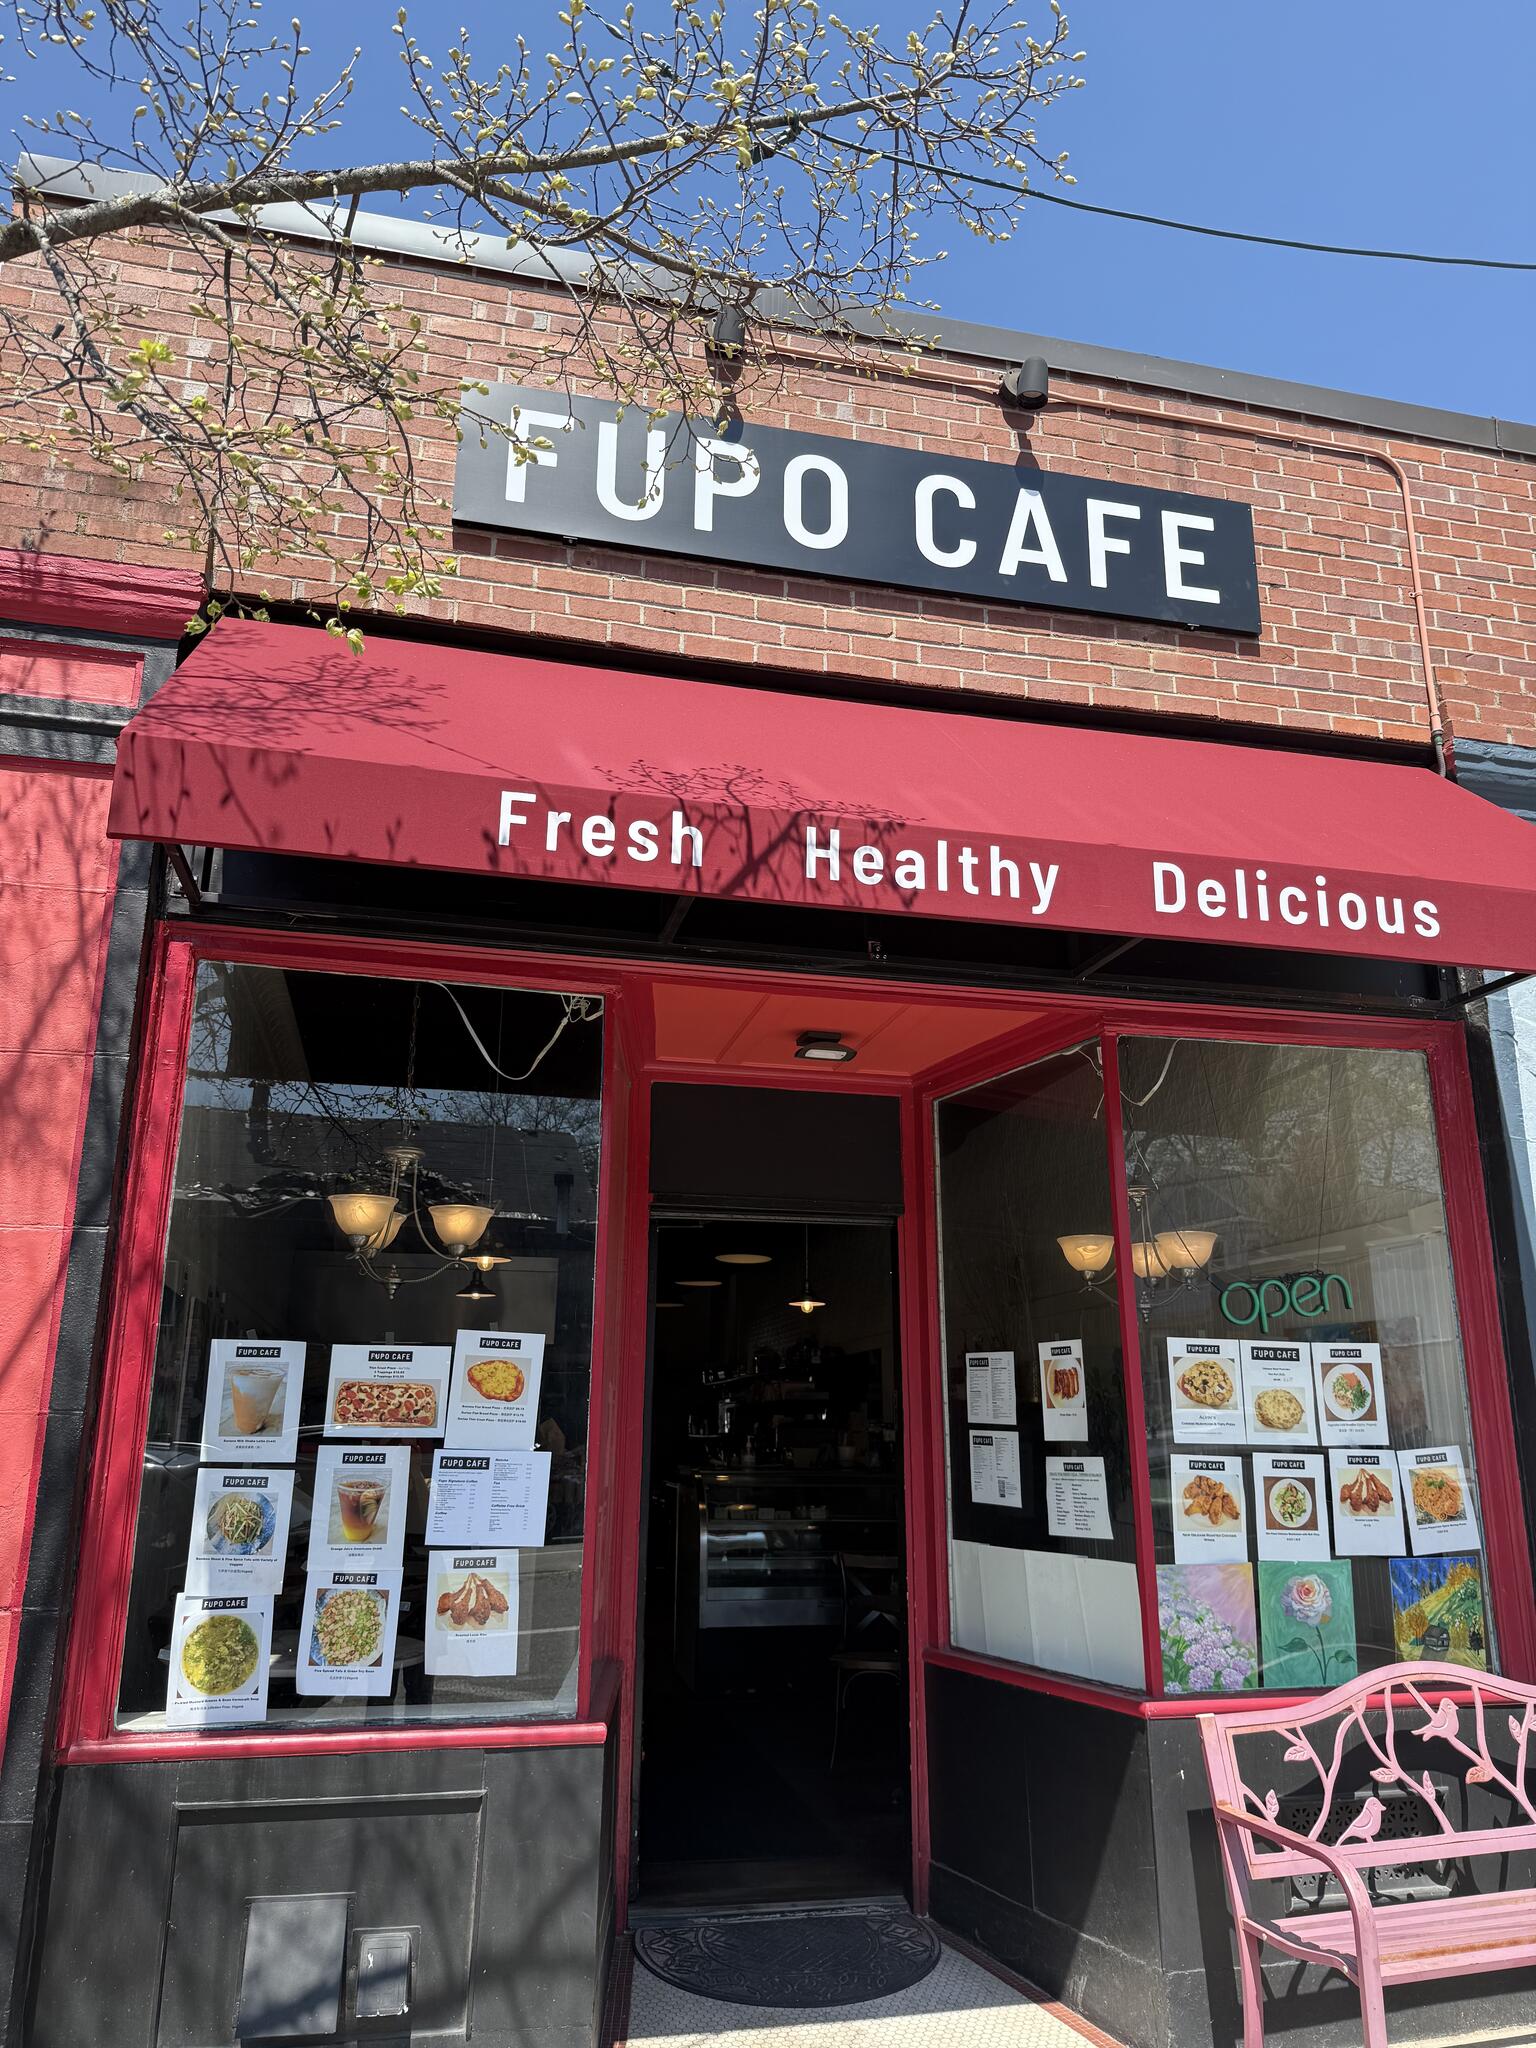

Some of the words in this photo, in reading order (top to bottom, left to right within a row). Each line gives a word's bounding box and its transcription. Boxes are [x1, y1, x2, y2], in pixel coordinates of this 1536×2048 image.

[504, 407, 849, 550] FUPO
[914, 473, 1221, 604] CAFE
[499, 790, 703, 867] Fresh
[804, 825, 1060, 915] Healthy
[1152, 861, 1441, 938] Delicious
[1220, 1273, 1353, 1334] open
[482, 1340, 500, 1348] FUPO
[370, 1352, 390, 1360] FUPO
[392, 1352, 411, 1361] CAFE
[1254, 1350, 1274, 1358] FUPO
[1276, 1350, 1298, 1359] CAFE
[442, 1459, 464, 1467] FUPO
[466, 1460, 487, 1468] CAFE
